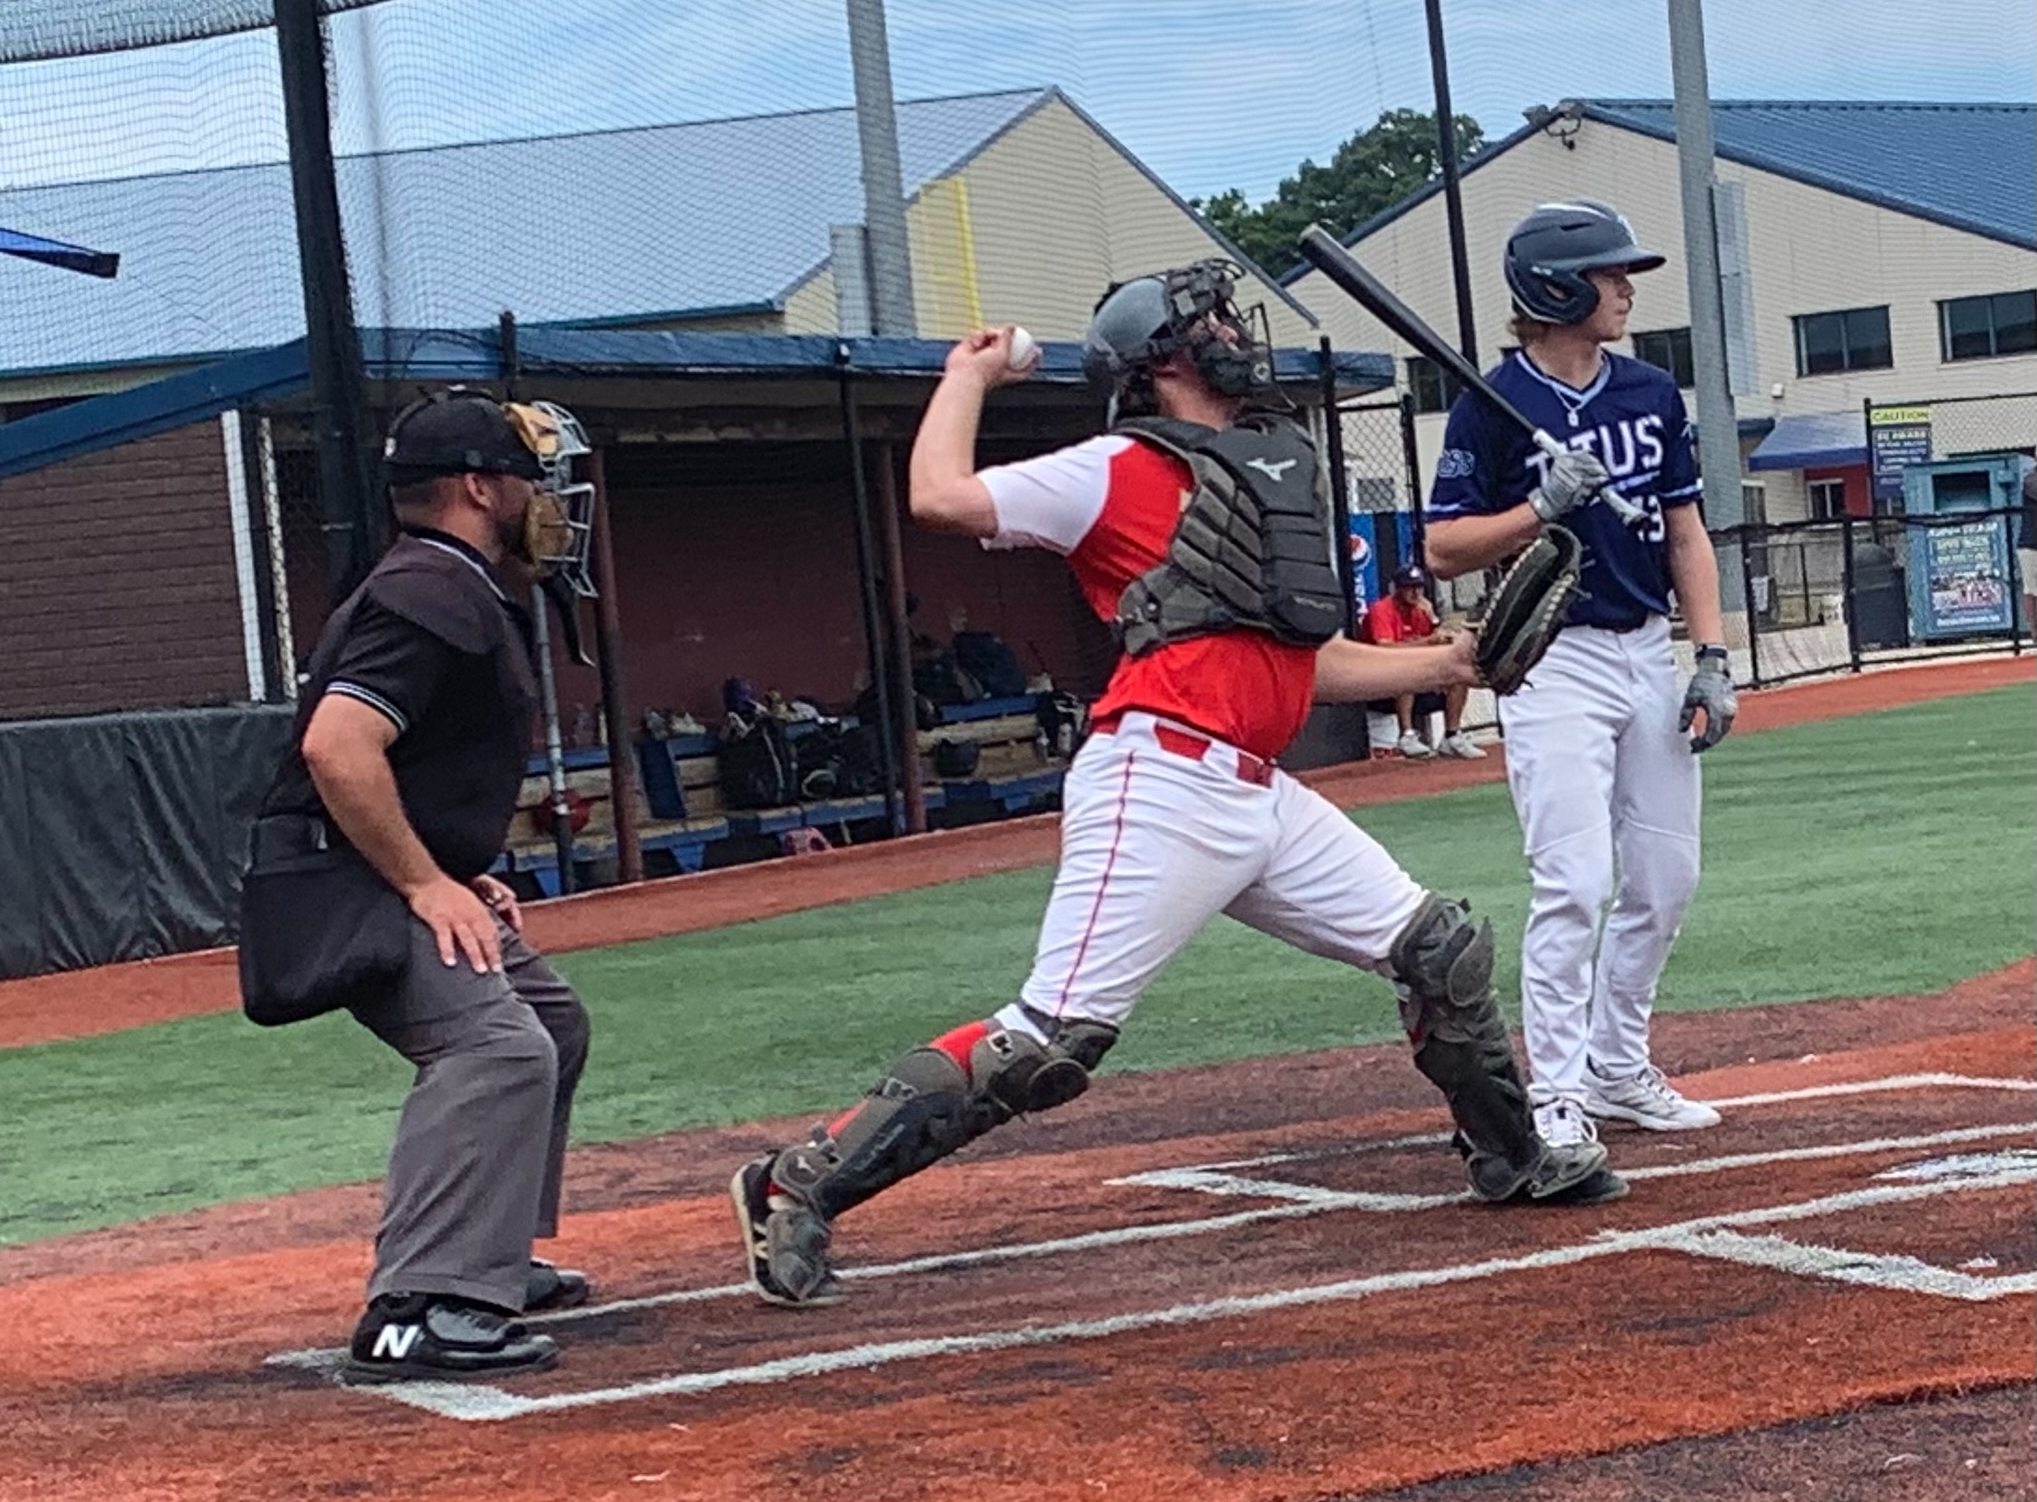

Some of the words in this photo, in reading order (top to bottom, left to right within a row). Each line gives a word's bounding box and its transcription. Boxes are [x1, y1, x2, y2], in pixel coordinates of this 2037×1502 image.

[1873, 410, 1929, 421] CAUTION
[1525, 414, 1664, 488] TTUS
[372, 1324, 420, 1359] N
